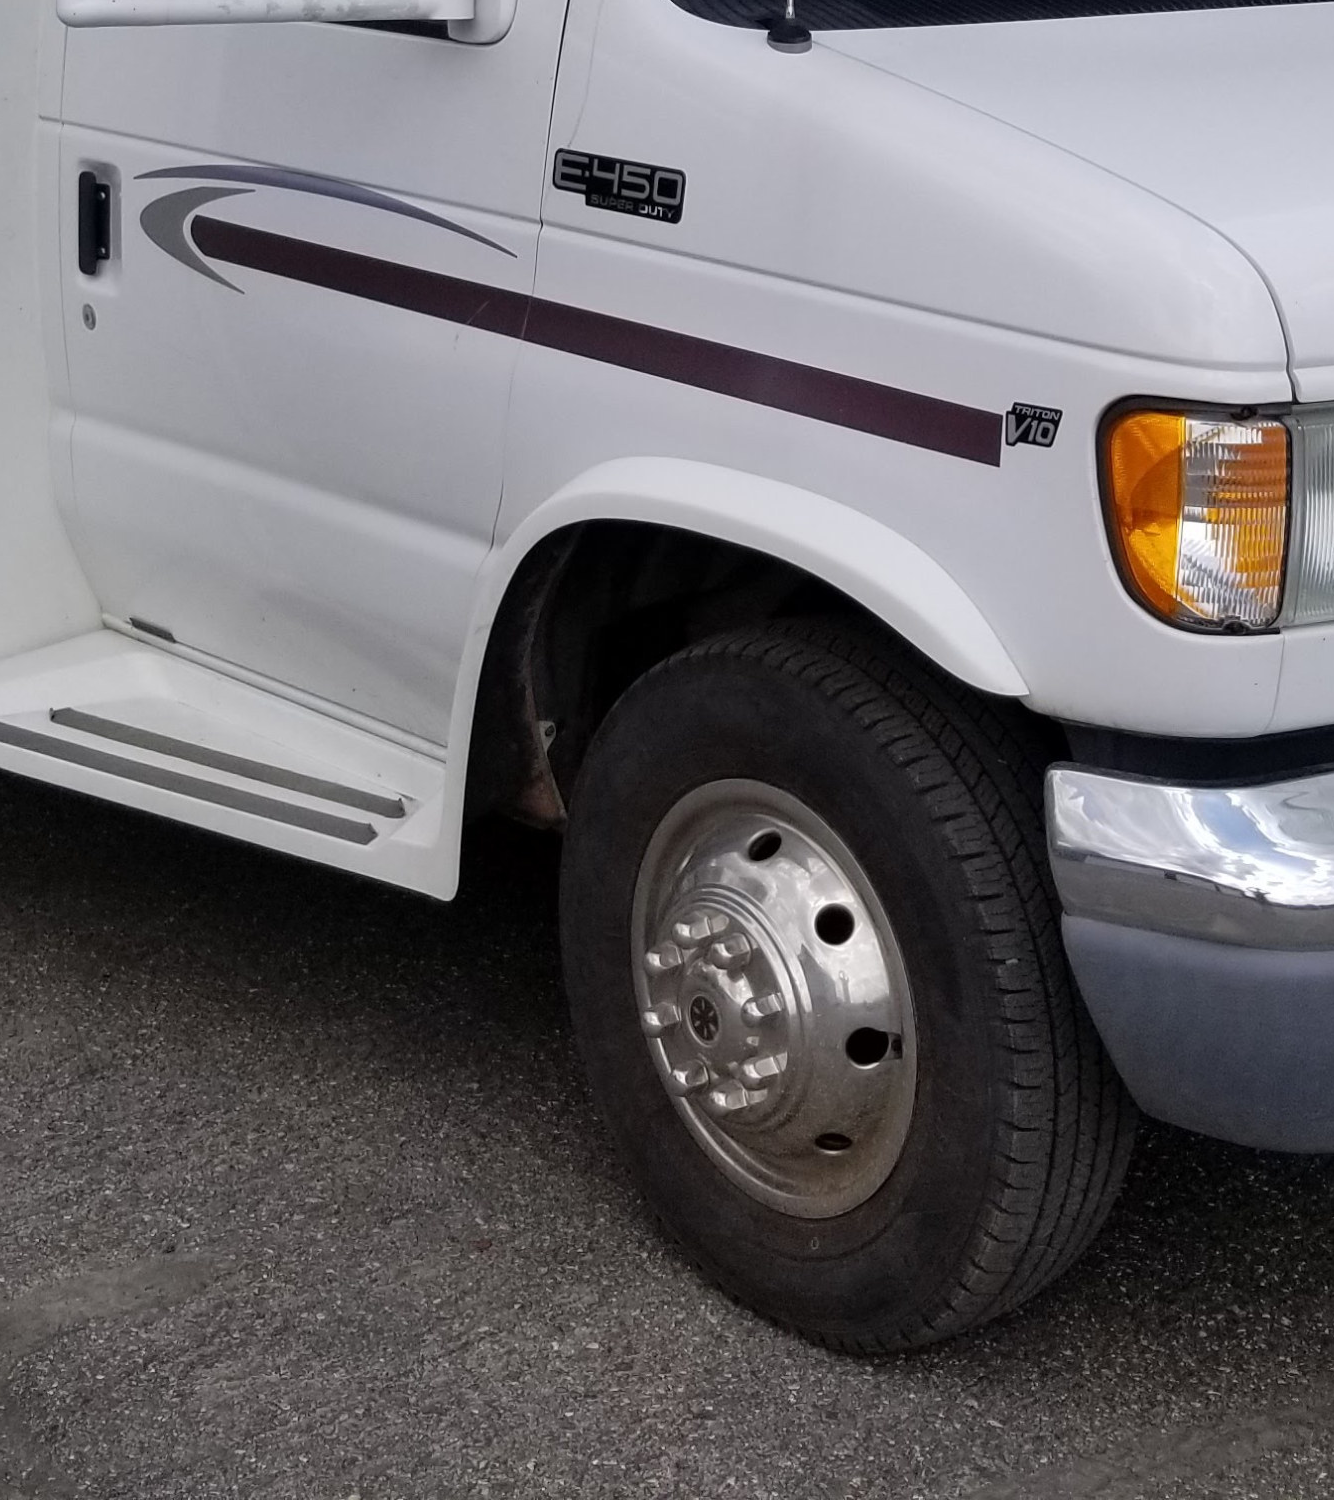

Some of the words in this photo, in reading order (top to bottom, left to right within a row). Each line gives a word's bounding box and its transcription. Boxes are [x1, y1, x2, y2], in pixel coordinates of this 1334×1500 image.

[589, 193, 635, 213] SUPER
[638, 203, 676, 220] DUTY
[1014, 404, 1061, 421] TRITON
[1007, 413, 1056, 446] V10
